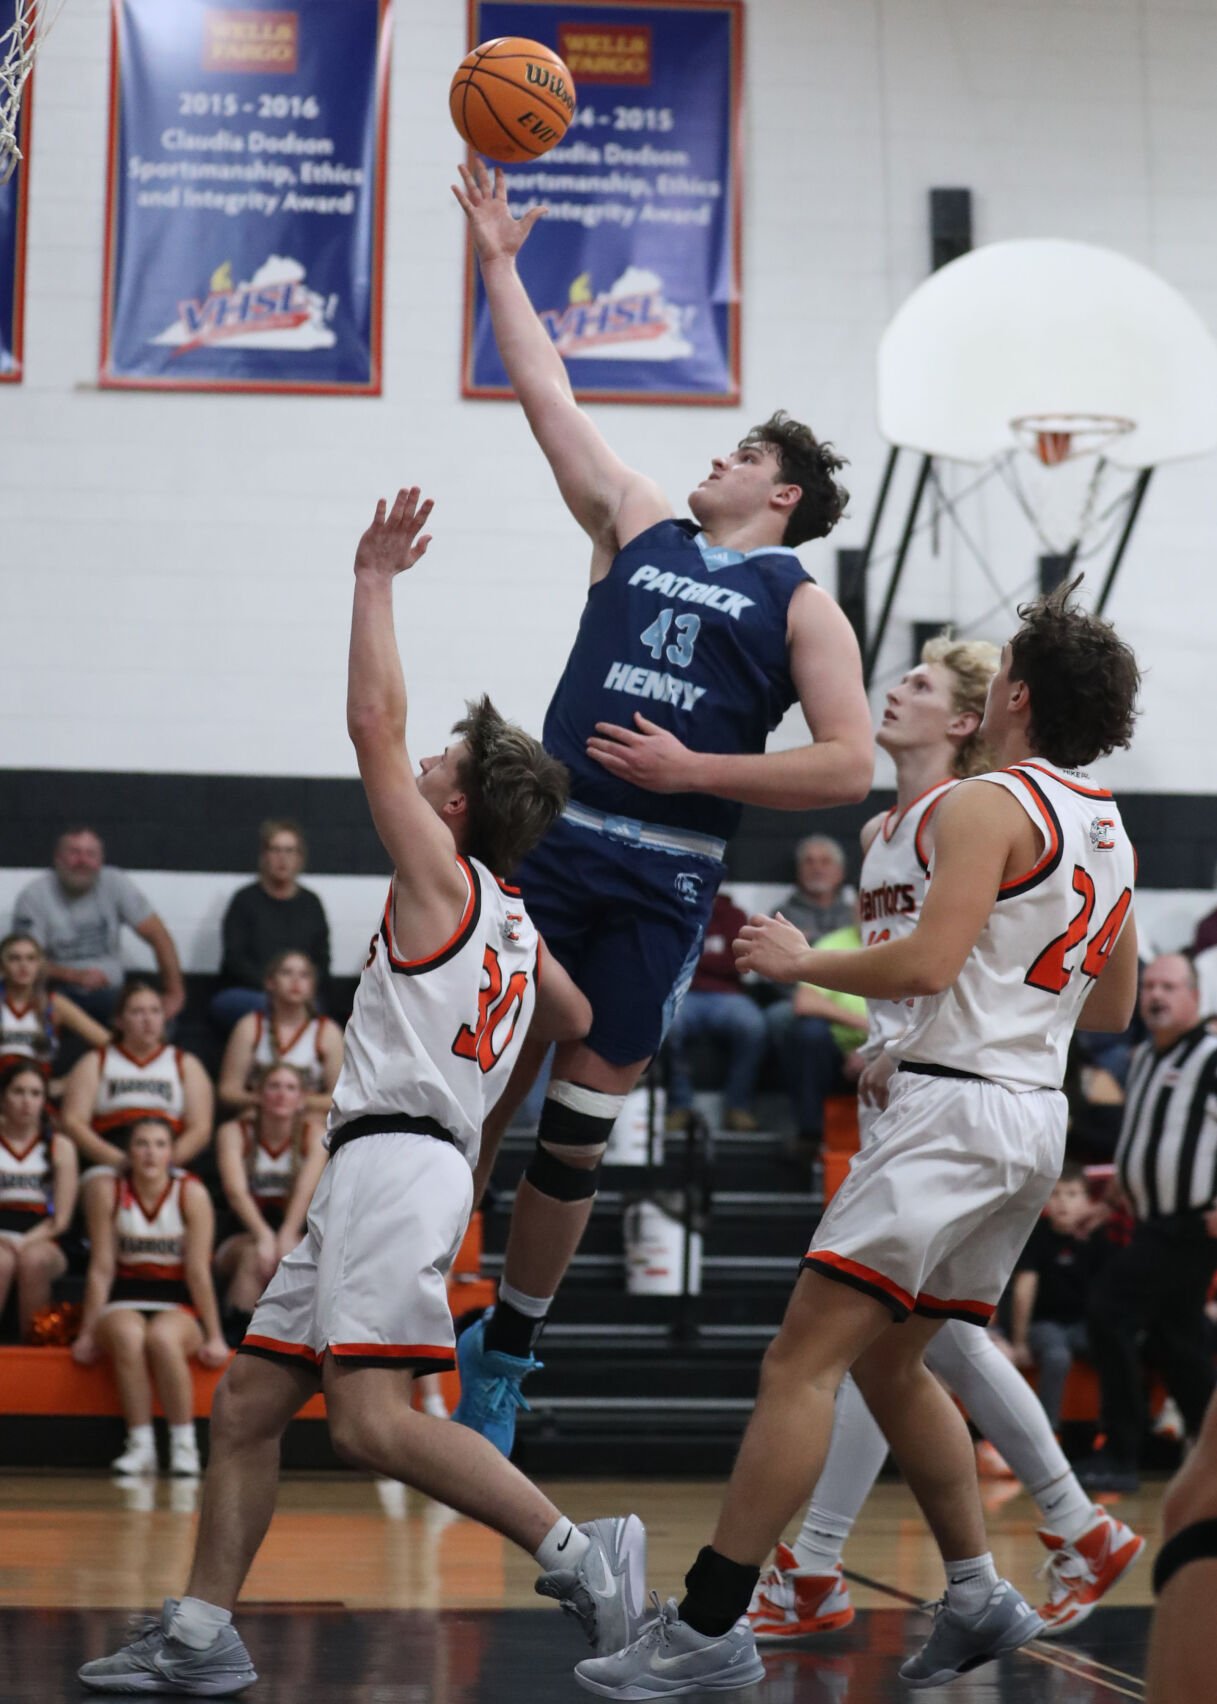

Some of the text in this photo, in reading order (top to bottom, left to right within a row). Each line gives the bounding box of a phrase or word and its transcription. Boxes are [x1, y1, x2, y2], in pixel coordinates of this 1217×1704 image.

[563, 34, 646, 53] WELLS
[180, 93, 238, 117] 2015
[258, 95, 320, 119] 2016
[613, 107, 675, 132] 2015
[161, 128, 334, 155] Claudia Dodson
[535, 142, 689, 167] audia Dodson
[128, 157, 365, 187] Sportsmanship, Ethics
[656, 173, 721, 197] Ethics
[137, 186, 355, 215] and Integrity Award
[639, 202, 712, 226] Award
[177, 280, 310, 335] VHSL
[539, 290, 668, 342] VHSL
[628, 564, 755, 621] PATRICK
[640, 608, 700, 668] 43
[603, 661, 708, 711] HENRY
[860, 881, 915, 921] arriors
[1023, 864, 1132, 998] 24
[452, 943, 528, 1073] 30
